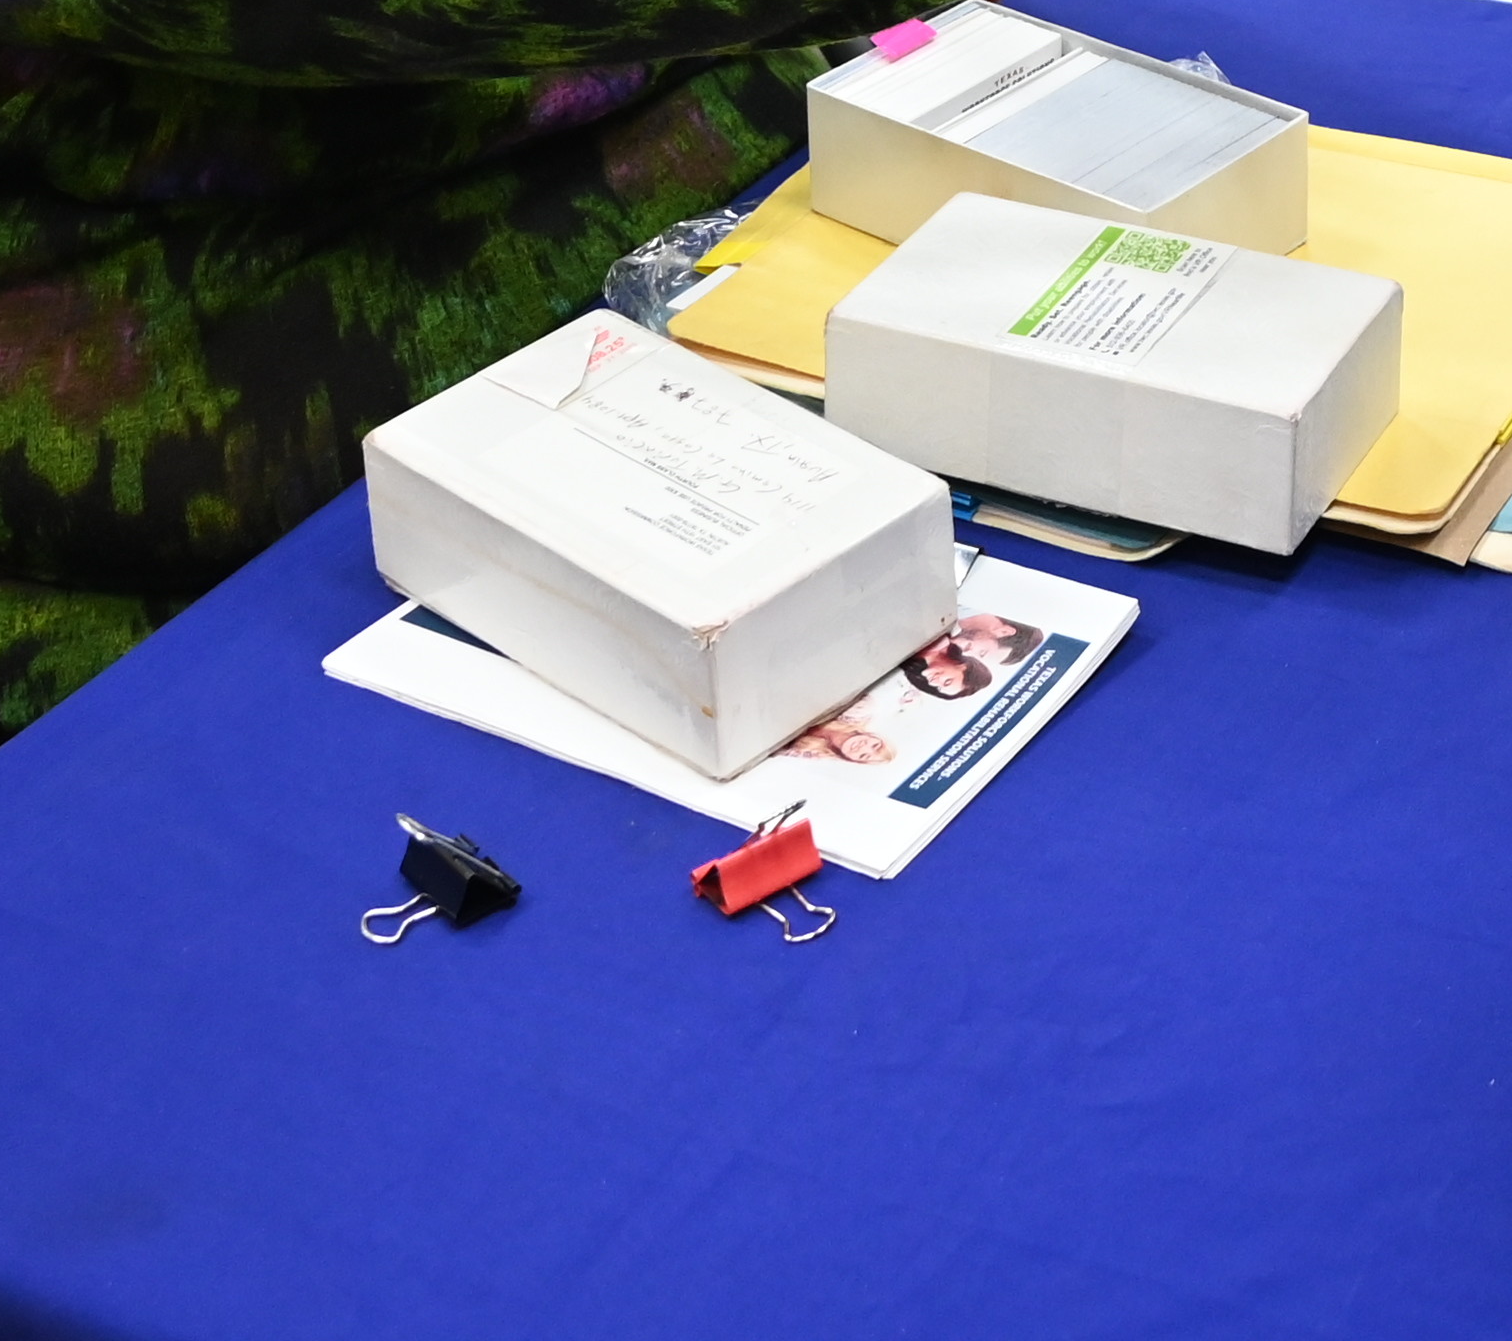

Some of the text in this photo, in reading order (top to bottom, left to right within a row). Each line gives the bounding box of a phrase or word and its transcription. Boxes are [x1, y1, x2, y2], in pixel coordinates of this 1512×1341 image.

[993, 65, 1026, 88] TEXAS
[1024, 308, 1043, 320] Put
[1037, 291, 1062, 308] your
[1050, 266, 1084, 292] abilities
[1076, 258, 1091, 266] to
[1030, 666, 1058, 693] TEXAS
[908, 648, 1057, 791] VOCATIONAL REHABILITATION SERVICES
[986, 688, 1035, 740] WORKFORCE
